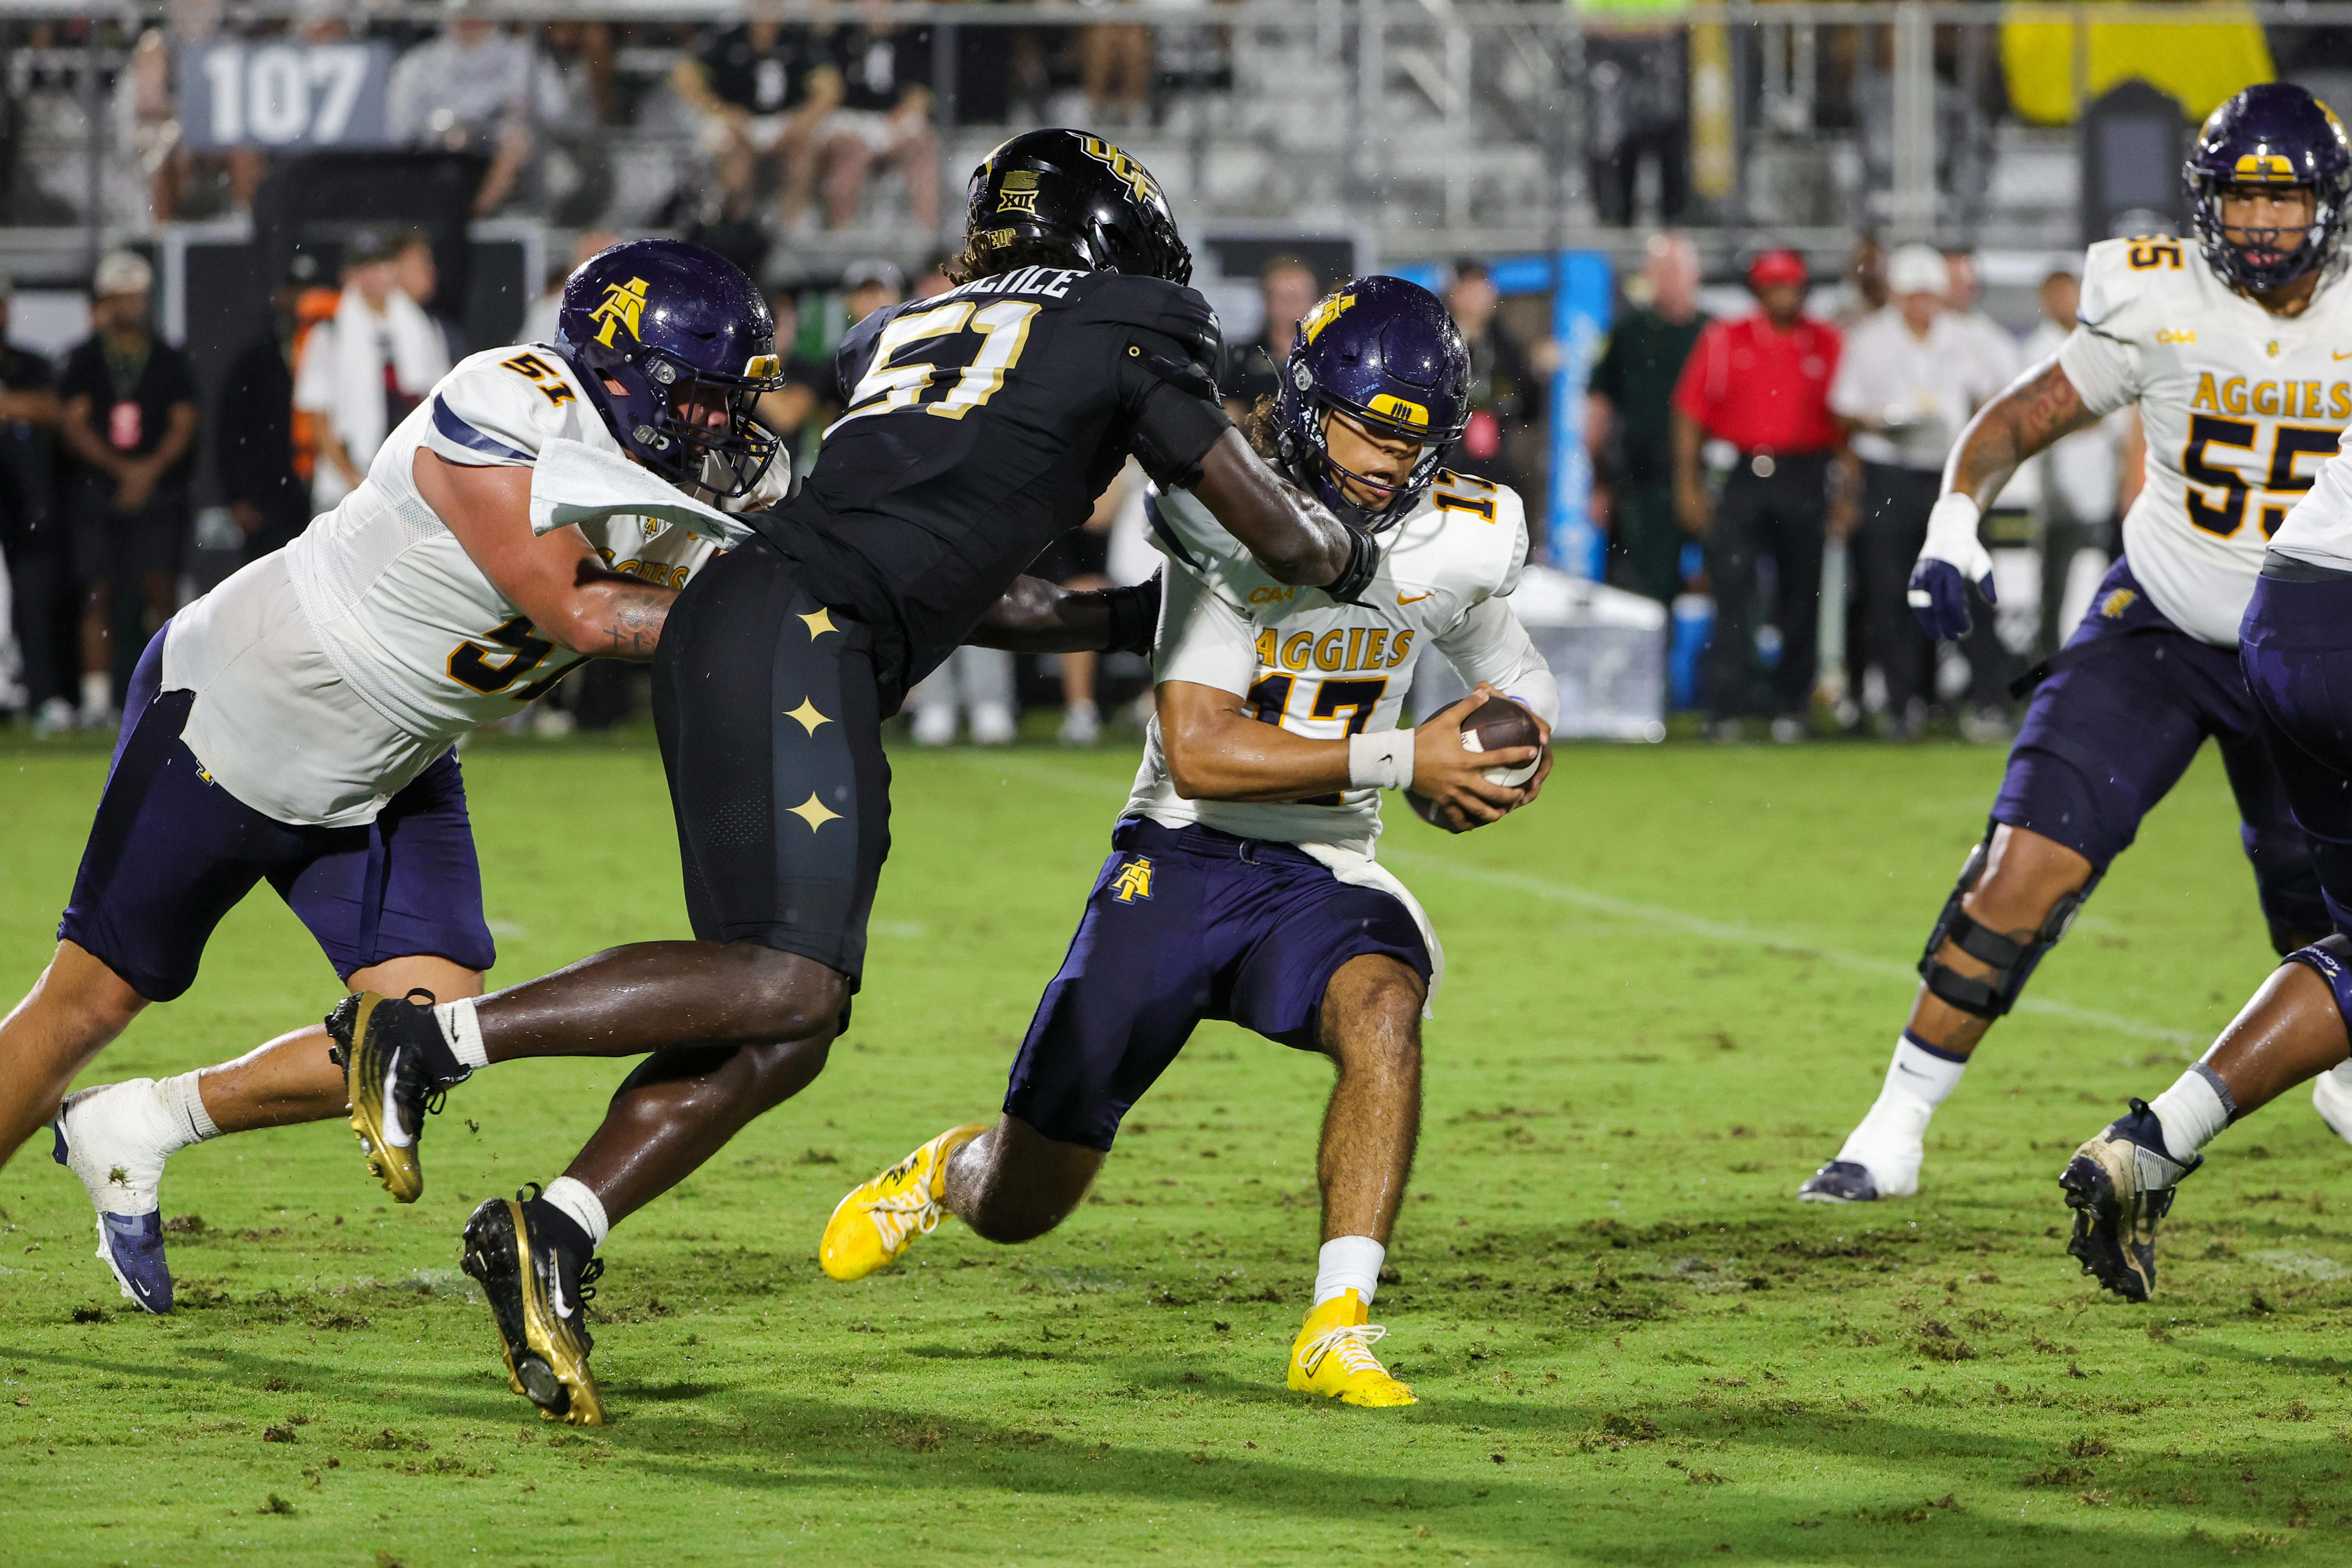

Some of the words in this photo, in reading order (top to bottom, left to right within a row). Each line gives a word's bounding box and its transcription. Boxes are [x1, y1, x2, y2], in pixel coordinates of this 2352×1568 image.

[205, 43, 370, 145] 107
[1066, 130, 1162, 204] UCF
[499, 352, 577, 408] 51
[821, 300, 1042, 441] 51
[2191, 372, 2352, 419] AGGIES
[2183, 413, 2345, 542] 55
[447, 613, 596, 702] 5
[1257, 627, 1415, 671] AGGIES
